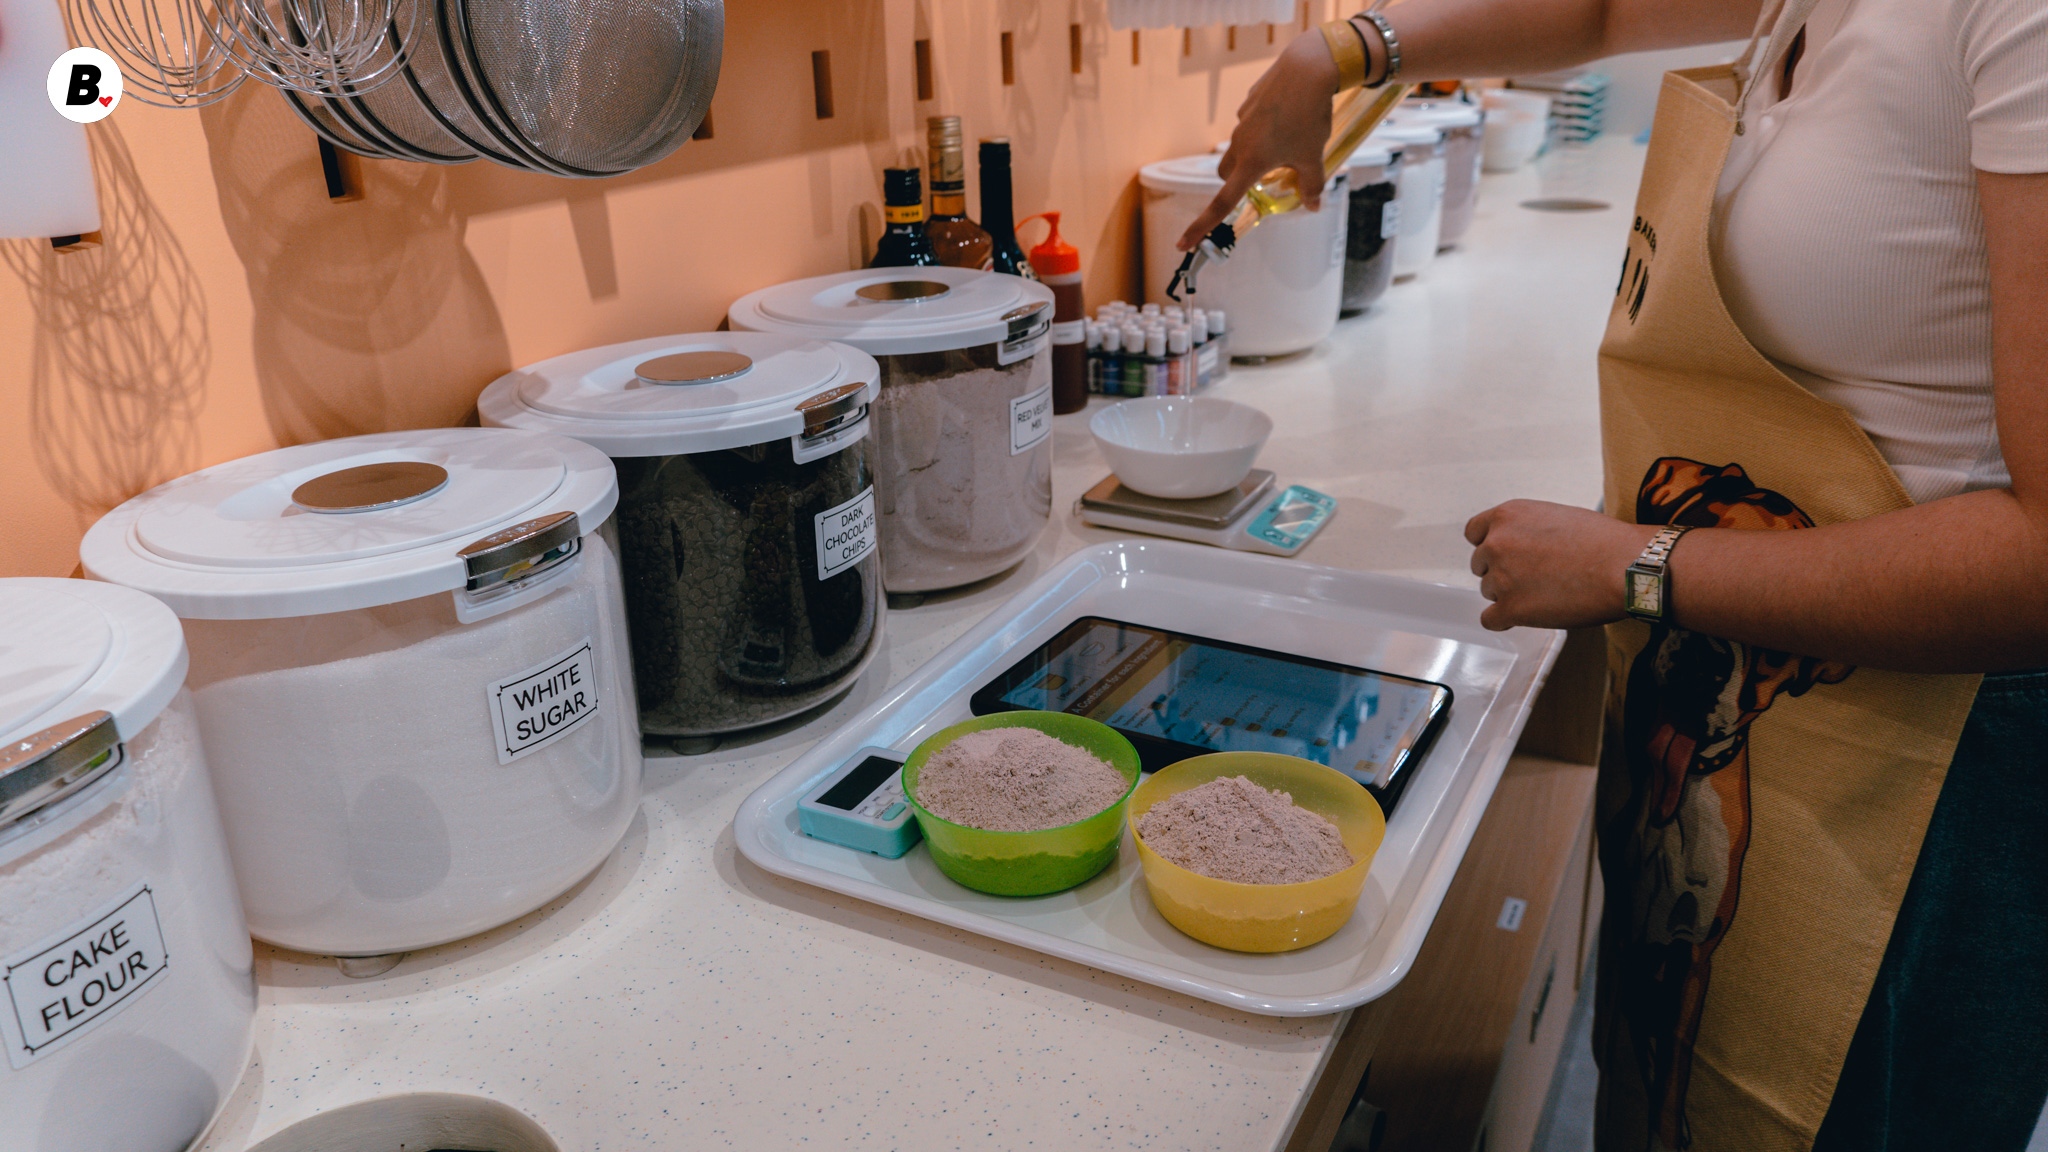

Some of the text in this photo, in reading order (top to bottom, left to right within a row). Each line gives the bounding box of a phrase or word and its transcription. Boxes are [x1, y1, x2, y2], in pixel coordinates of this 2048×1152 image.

[1017, 409, 1032, 423] RED
[825, 513, 874, 550] CHOCOLATE
[841, 505, 864, 527] DARK
[842, 536, 866, 559] CHIPS
[513, 663, 581, 711] WHITE
[516, 691, 587, 741] SUGAR
[44, 920, 130, 987] CAKE
[41, 951, 149, 1032] FLOUR
